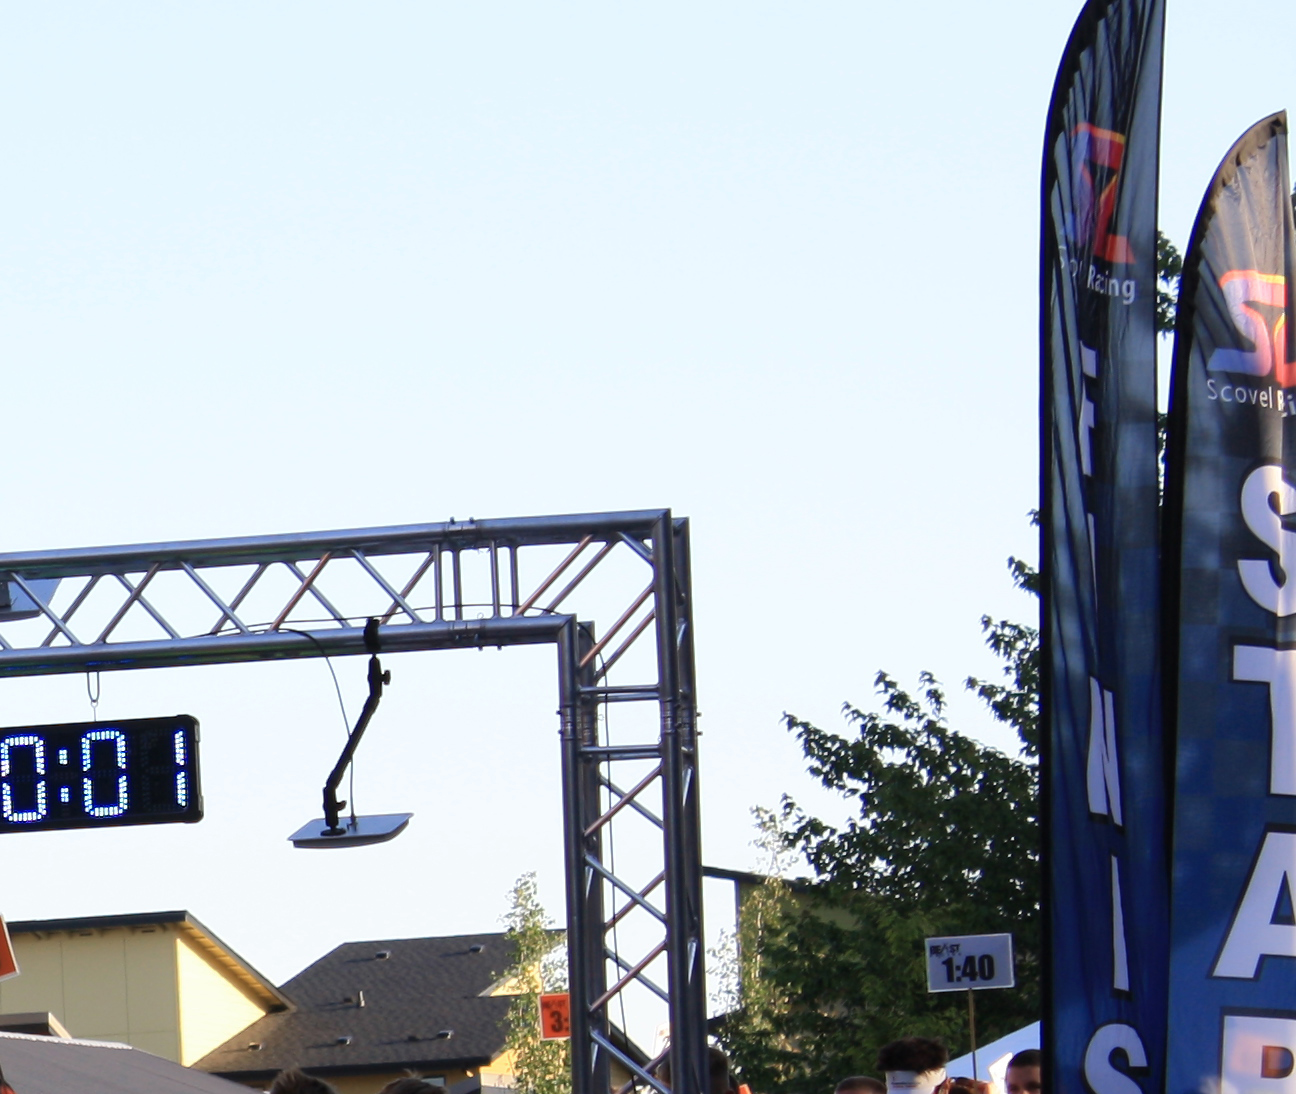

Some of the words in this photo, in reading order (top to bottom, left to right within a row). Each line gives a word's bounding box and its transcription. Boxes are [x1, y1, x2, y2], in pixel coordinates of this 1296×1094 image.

[1087, 264, 1135, 305] Raing
[1207, 378, 1273, 409] Scovel
[941, 953, 995, 983] 1:40
